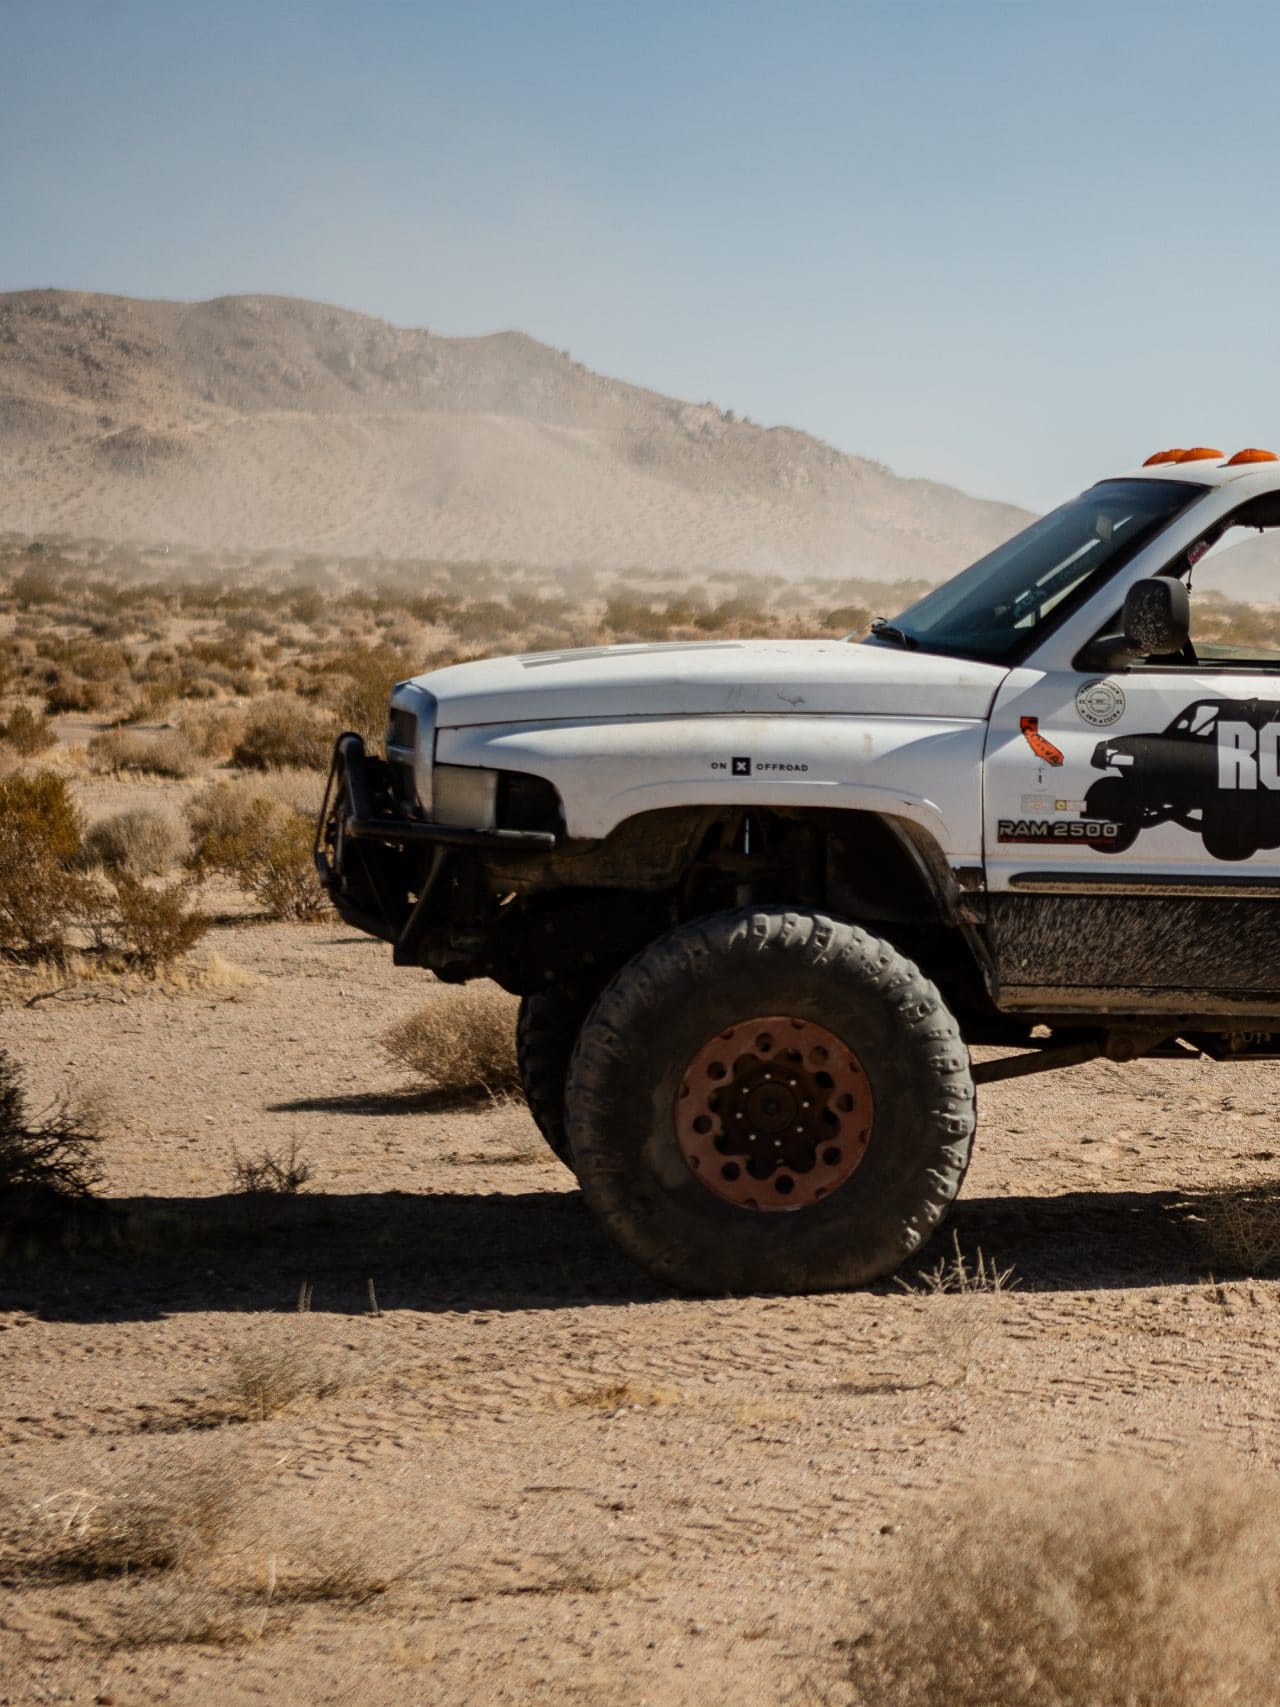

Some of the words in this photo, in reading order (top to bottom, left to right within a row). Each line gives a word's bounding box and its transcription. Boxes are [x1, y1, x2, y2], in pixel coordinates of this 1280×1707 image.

[711, 762, 727, 770] ON
[756, 763, 809, 772] OFFROAD
[1000, 822, 1048, 836] RAM
[1054, 823, 1118, 837] 2500
